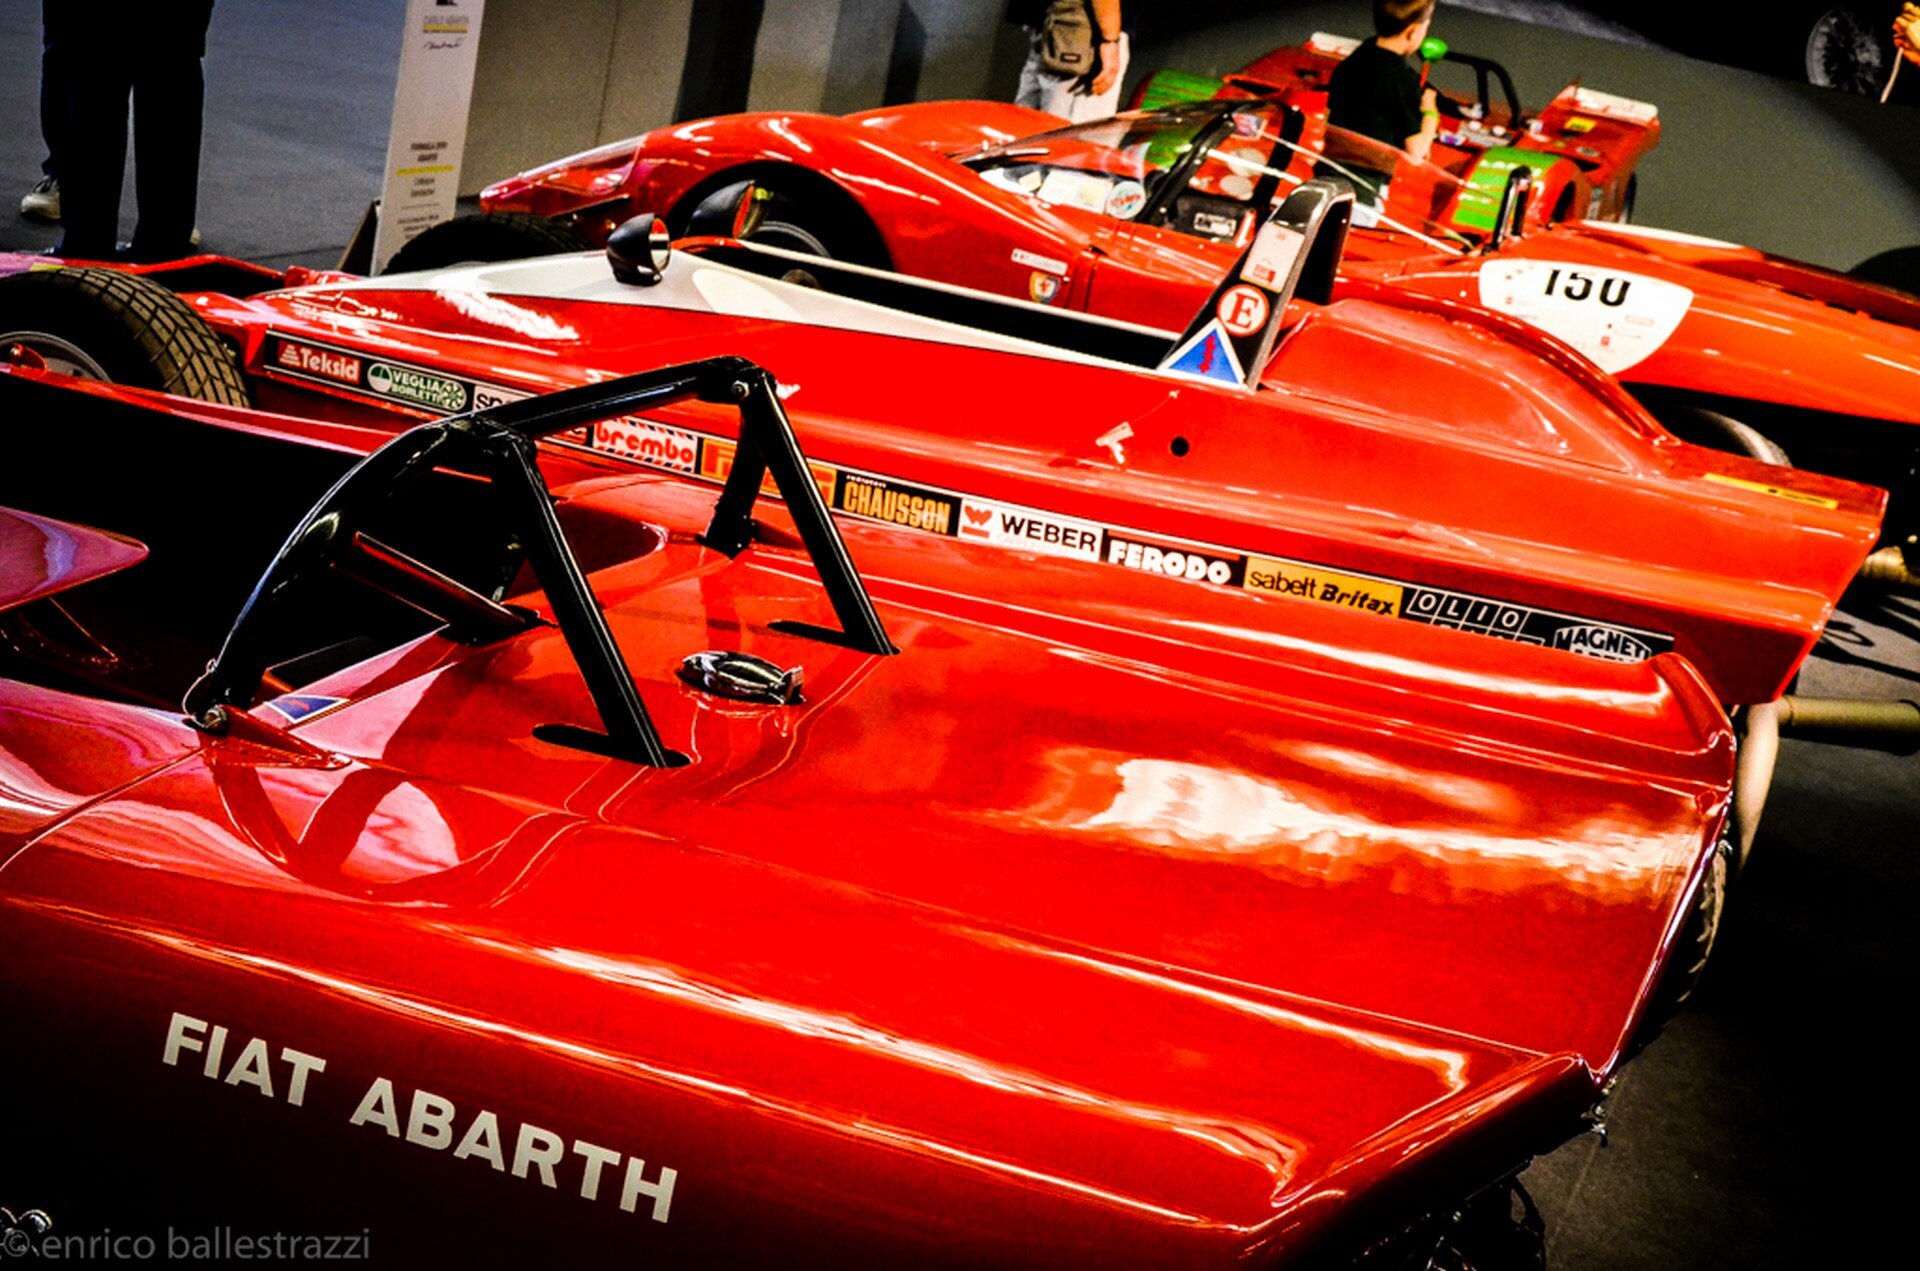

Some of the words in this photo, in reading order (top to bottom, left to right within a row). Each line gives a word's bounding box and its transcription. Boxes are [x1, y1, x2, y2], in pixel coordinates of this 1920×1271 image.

[1544, 269, 1632, 307] 150
[1226, 292, 1259, 329] E
[299, 348, 359, 382] Teksid
[391, 369, 441, 392] VEGLIA
[595, 421, 694, 464] brembo
[843, 481, 951, 534] CHAUSSON
[1001, 512, 1097, 553] WEBER
[1108, 539, 1232, 586] FERODO
[1249, 569, 1318, 600] sabelt
[1318, 582, 1395, 616] Britax
[1418, 593, 1520, 628] OLIO
[1556, 627, 1650, 661] MAGNETI
[162, 1011, 327, 1107] FIAT
[350, 1076, 678, 1224] ABARTH
